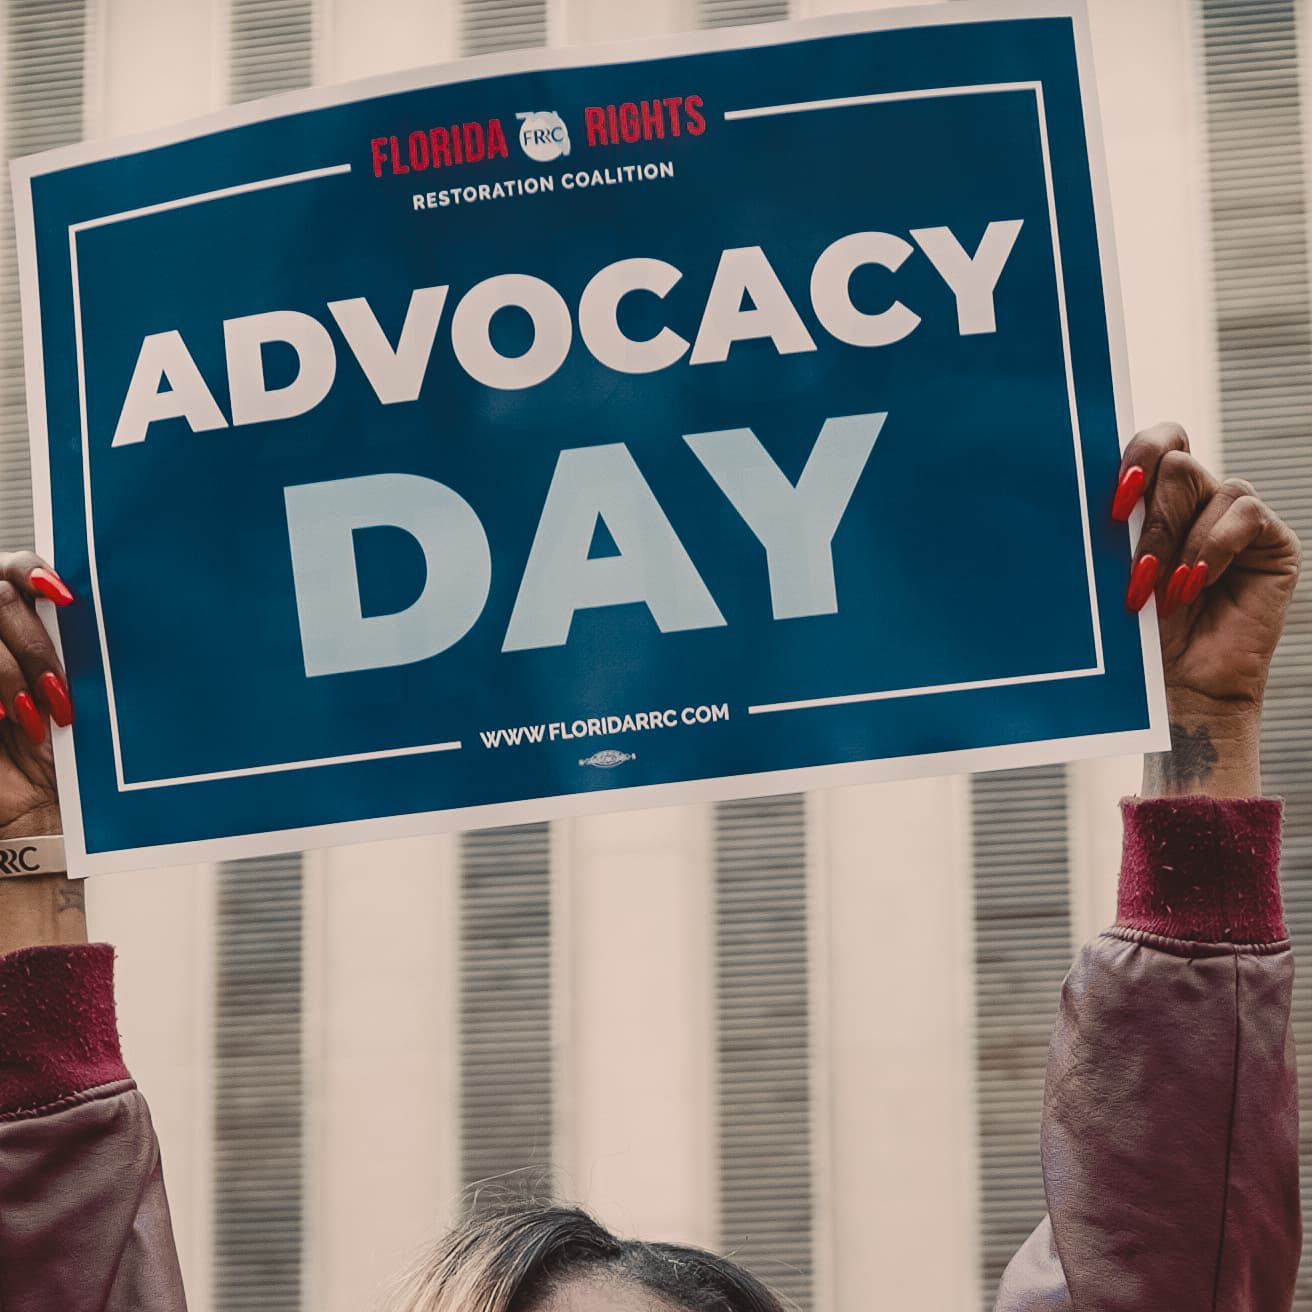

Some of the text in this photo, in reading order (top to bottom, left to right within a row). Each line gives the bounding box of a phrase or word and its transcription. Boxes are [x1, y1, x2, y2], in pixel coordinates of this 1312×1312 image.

[370, 118, 509, 178] FLORIDA
[584, 95, 707, 147] RIGHTS
[412, 161, 675, 211] RESTORATION COALITION
[111, 219, 1024, 448] ADVOCACY
[283, 411, 888, 678] DAY
